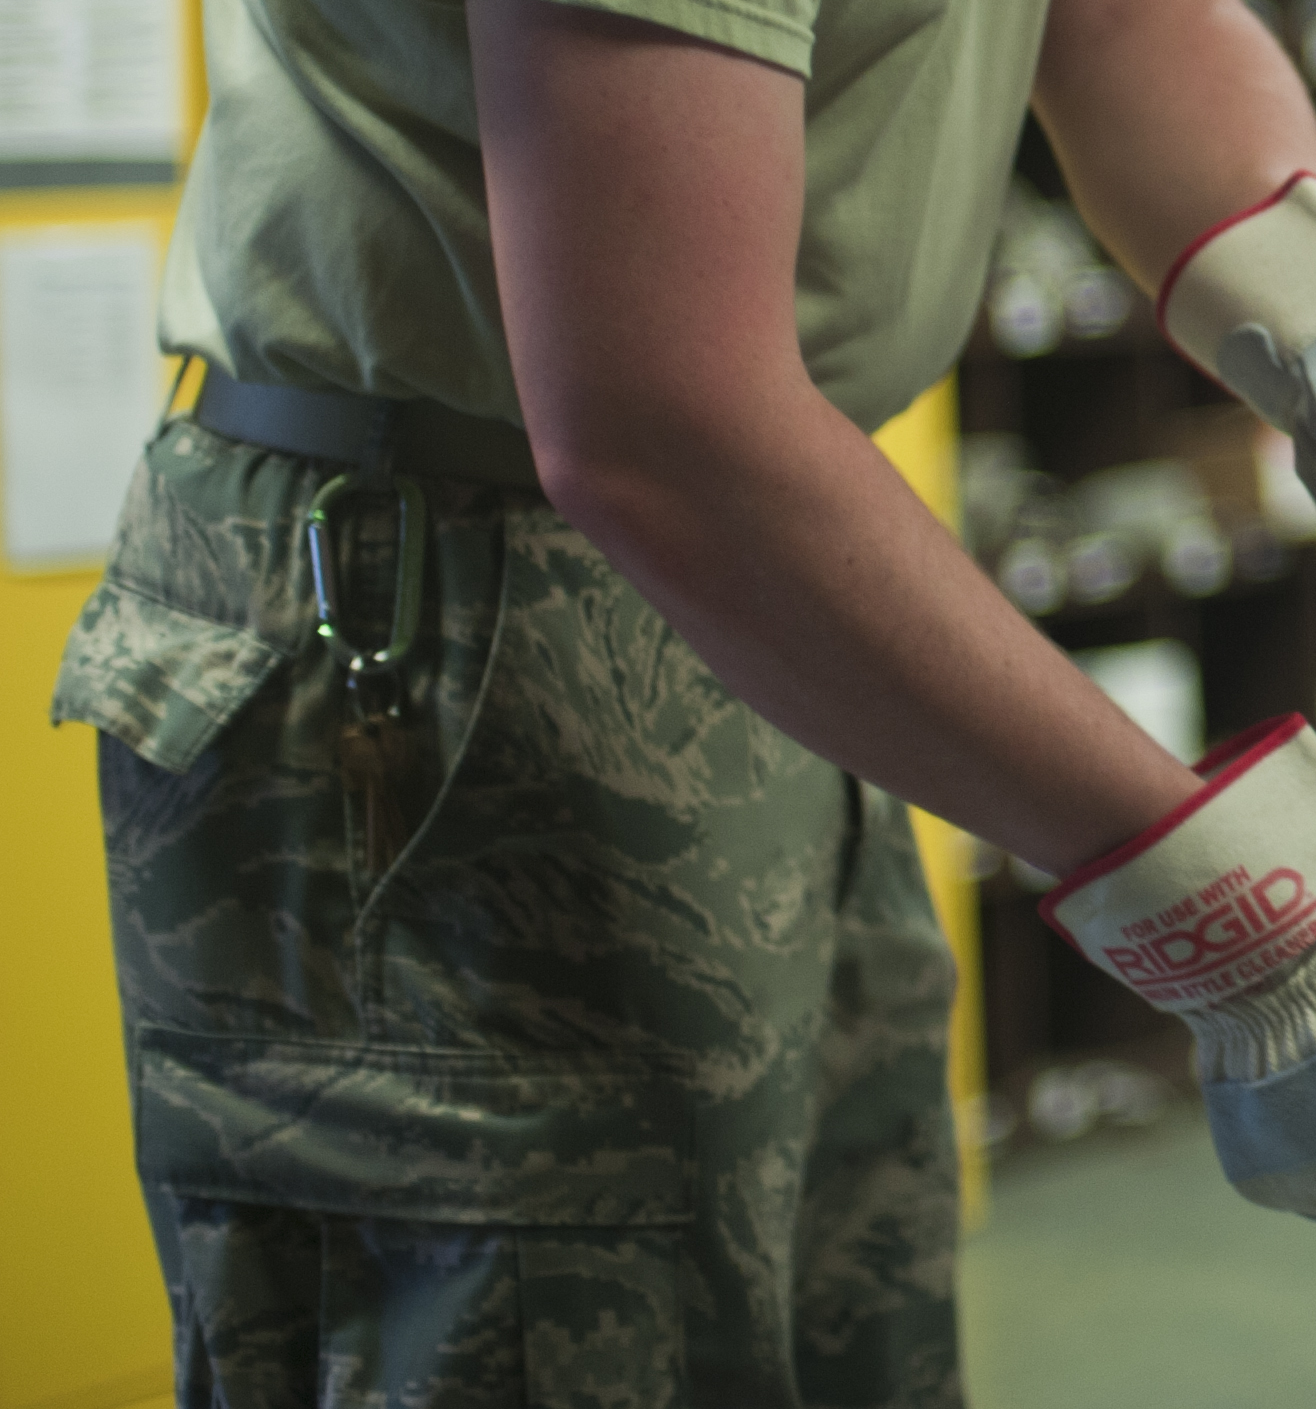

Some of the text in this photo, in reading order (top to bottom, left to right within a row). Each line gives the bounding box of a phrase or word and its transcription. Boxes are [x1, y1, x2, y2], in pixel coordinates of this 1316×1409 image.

[1102, 866, 1304, 982] RIDGID
[1120, 863, 1252, 941] FOR USE WITH
